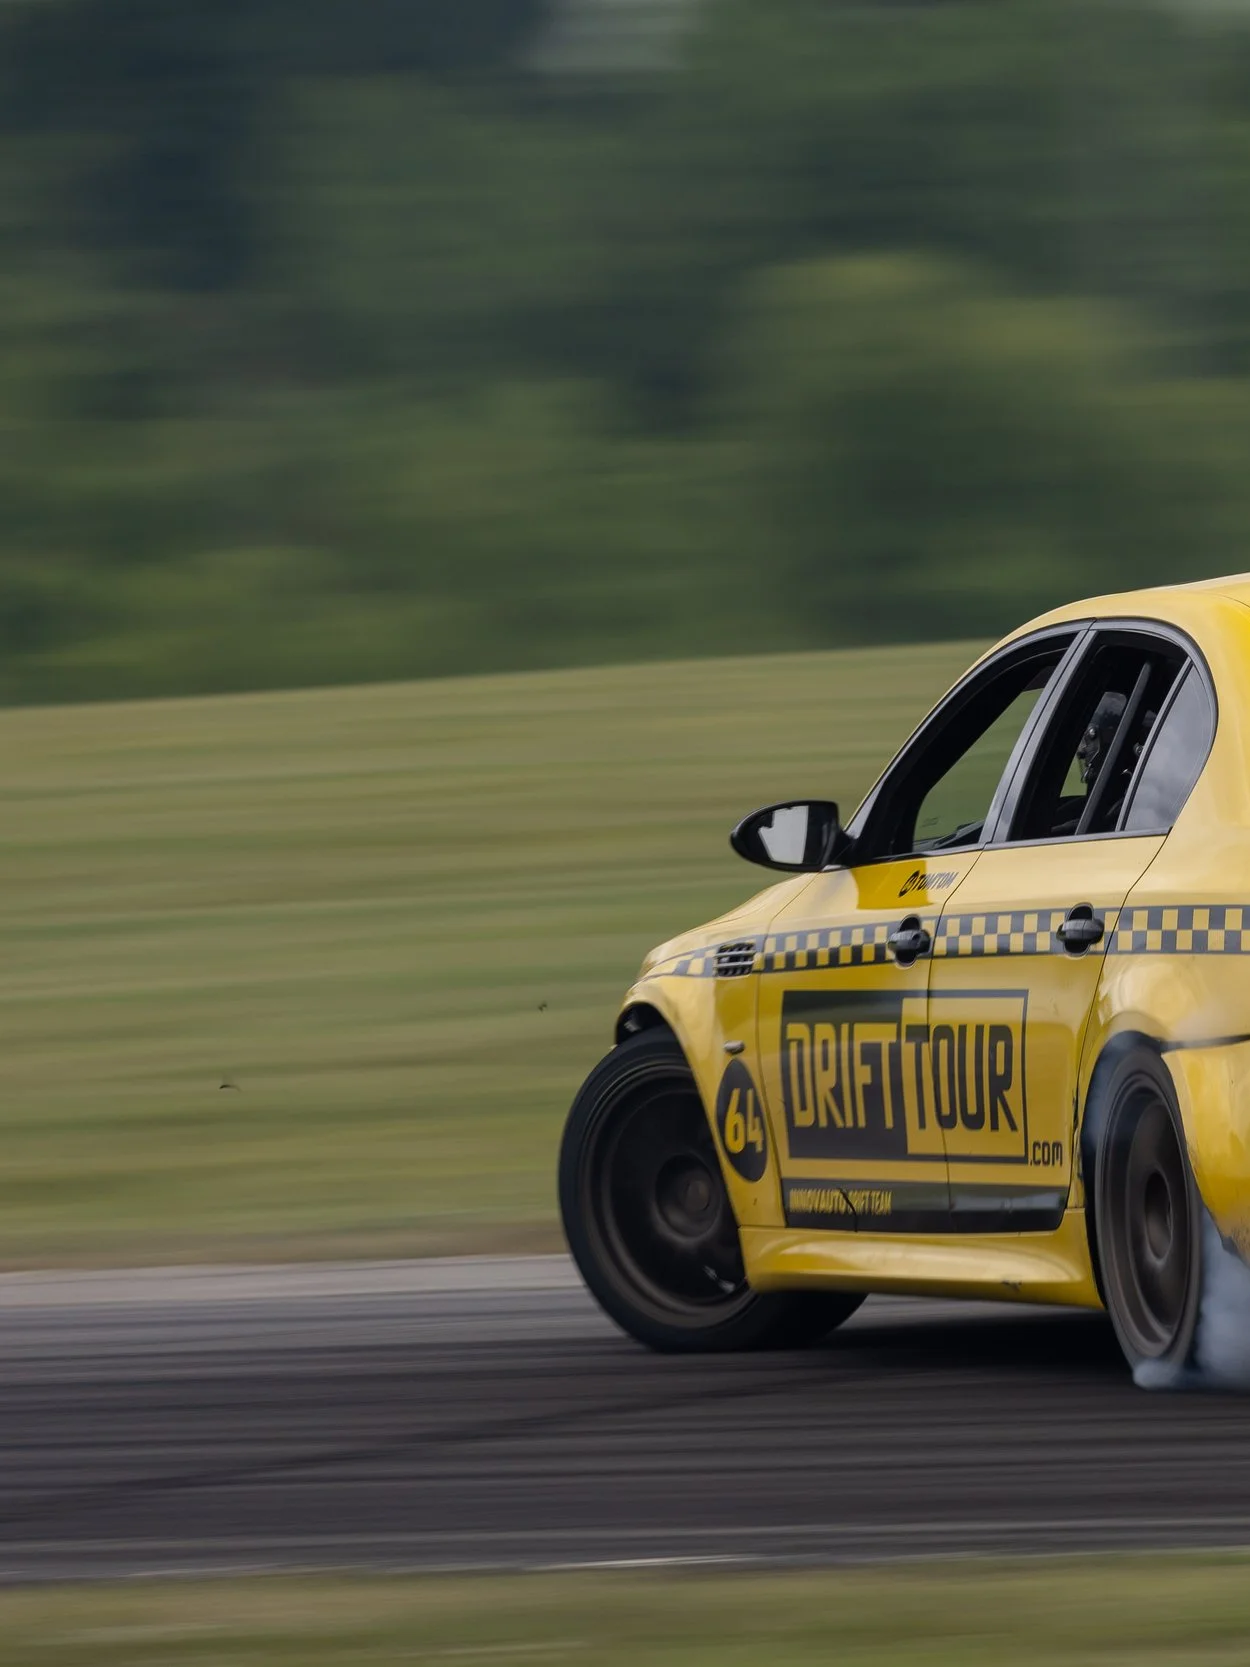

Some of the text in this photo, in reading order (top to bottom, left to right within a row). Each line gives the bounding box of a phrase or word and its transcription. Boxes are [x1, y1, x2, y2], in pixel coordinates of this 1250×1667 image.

[786, 1022, 898, 1129] DRIFT
[905, 1023, 1018, 1132] TOUR
[725, 1087, 764, 1154] 64
[871, 1190, 892, 1215] TEAM
